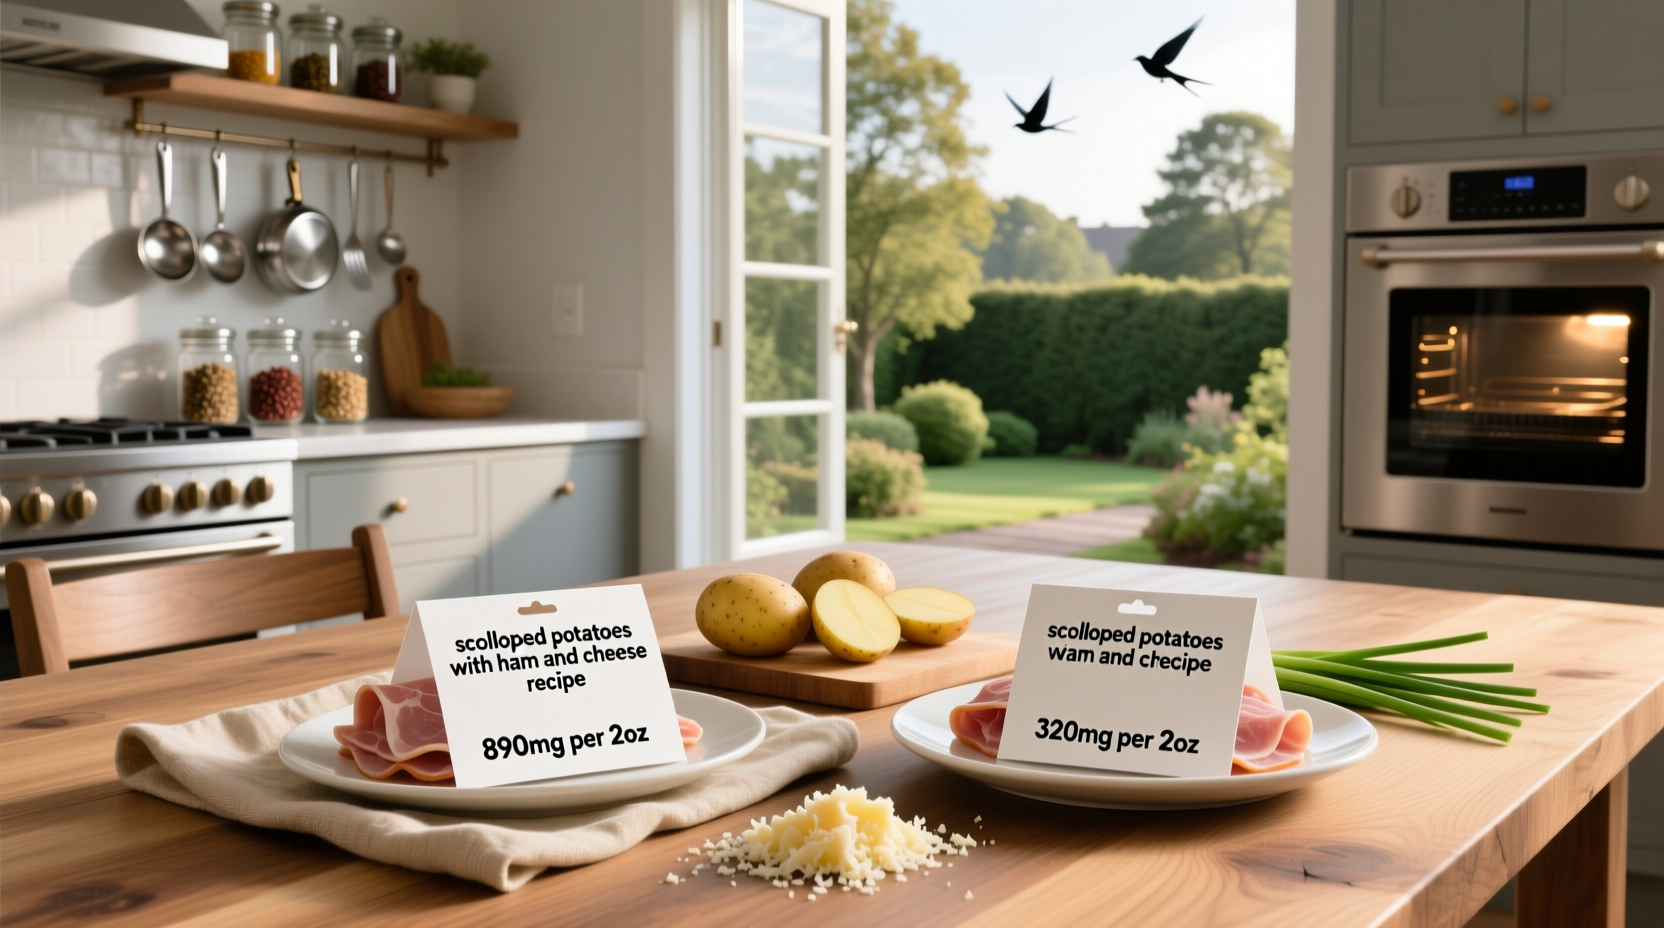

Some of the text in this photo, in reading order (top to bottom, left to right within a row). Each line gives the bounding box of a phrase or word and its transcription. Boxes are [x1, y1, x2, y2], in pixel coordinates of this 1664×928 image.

[455, 624, 633, 654] scolloped potatoes
[1047, 621, 1224, 651] scolloped potatoes
[449, 644, 648, 677] with ham and cheese
[1098, 647, 1136, 667] and
[526, 671, 587, 694] recipe
[482, 723, 650, 760] 890mg per 2oz
[1034, 717, 1200, 754] 320mg per 2oz
